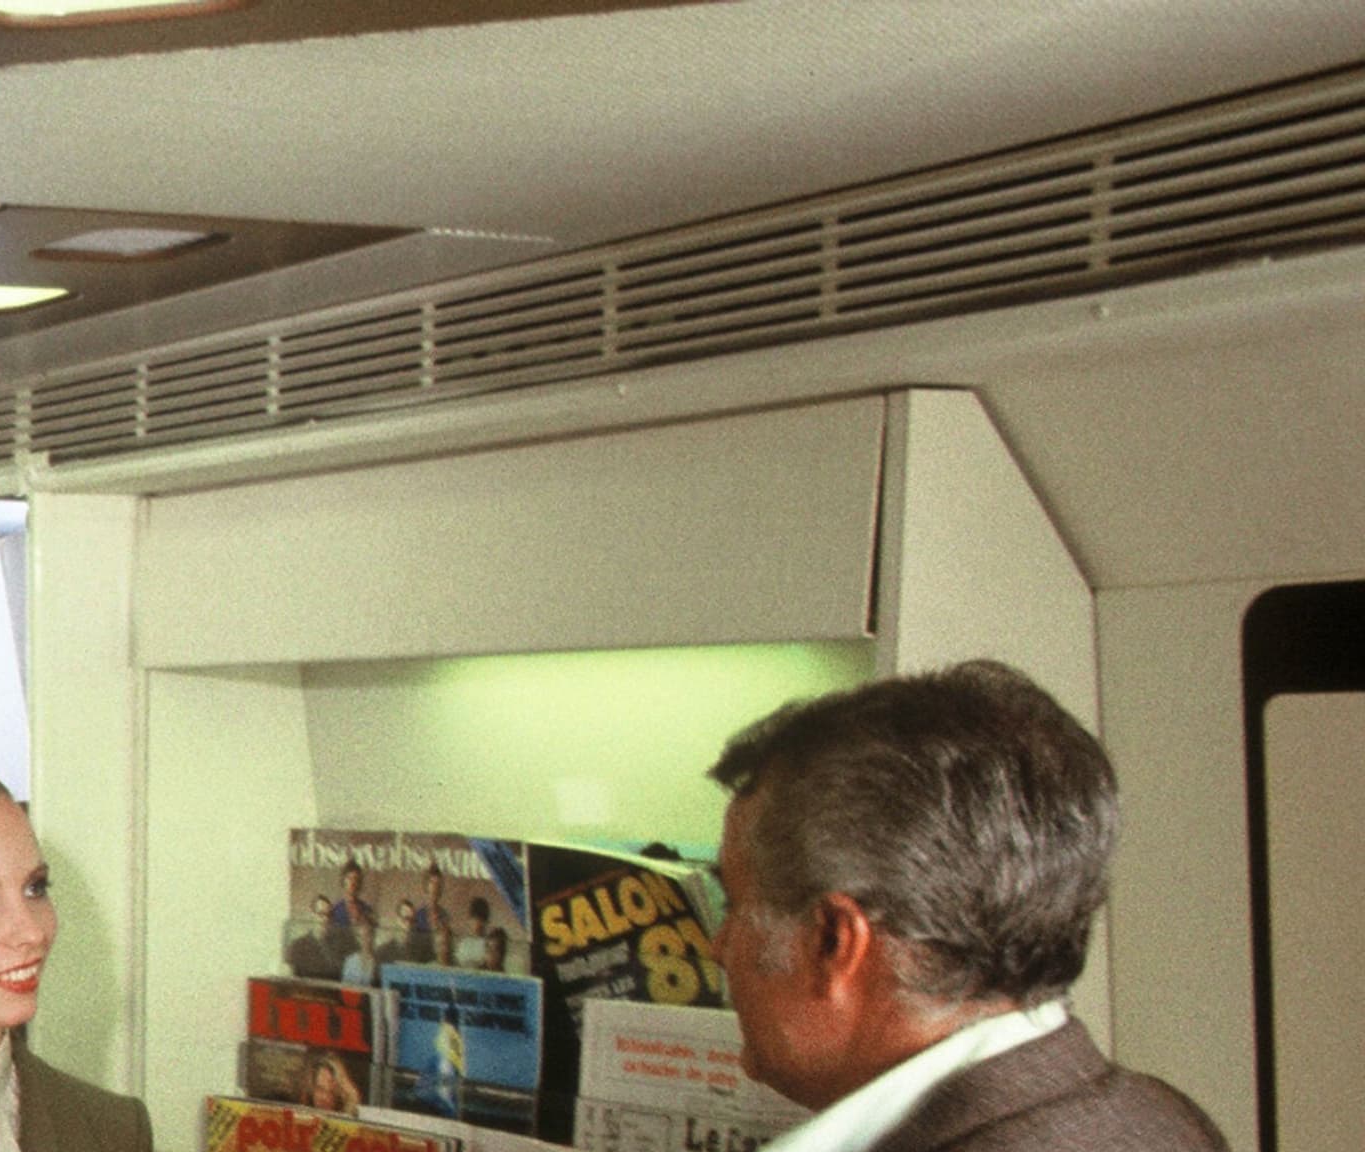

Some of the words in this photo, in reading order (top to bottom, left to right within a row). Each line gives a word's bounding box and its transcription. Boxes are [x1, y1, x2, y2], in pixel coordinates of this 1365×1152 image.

[540, 870, 686, 958] SALON
[637, 916, 722, 1005] 81
[247, 979, 373, 1053] lui
